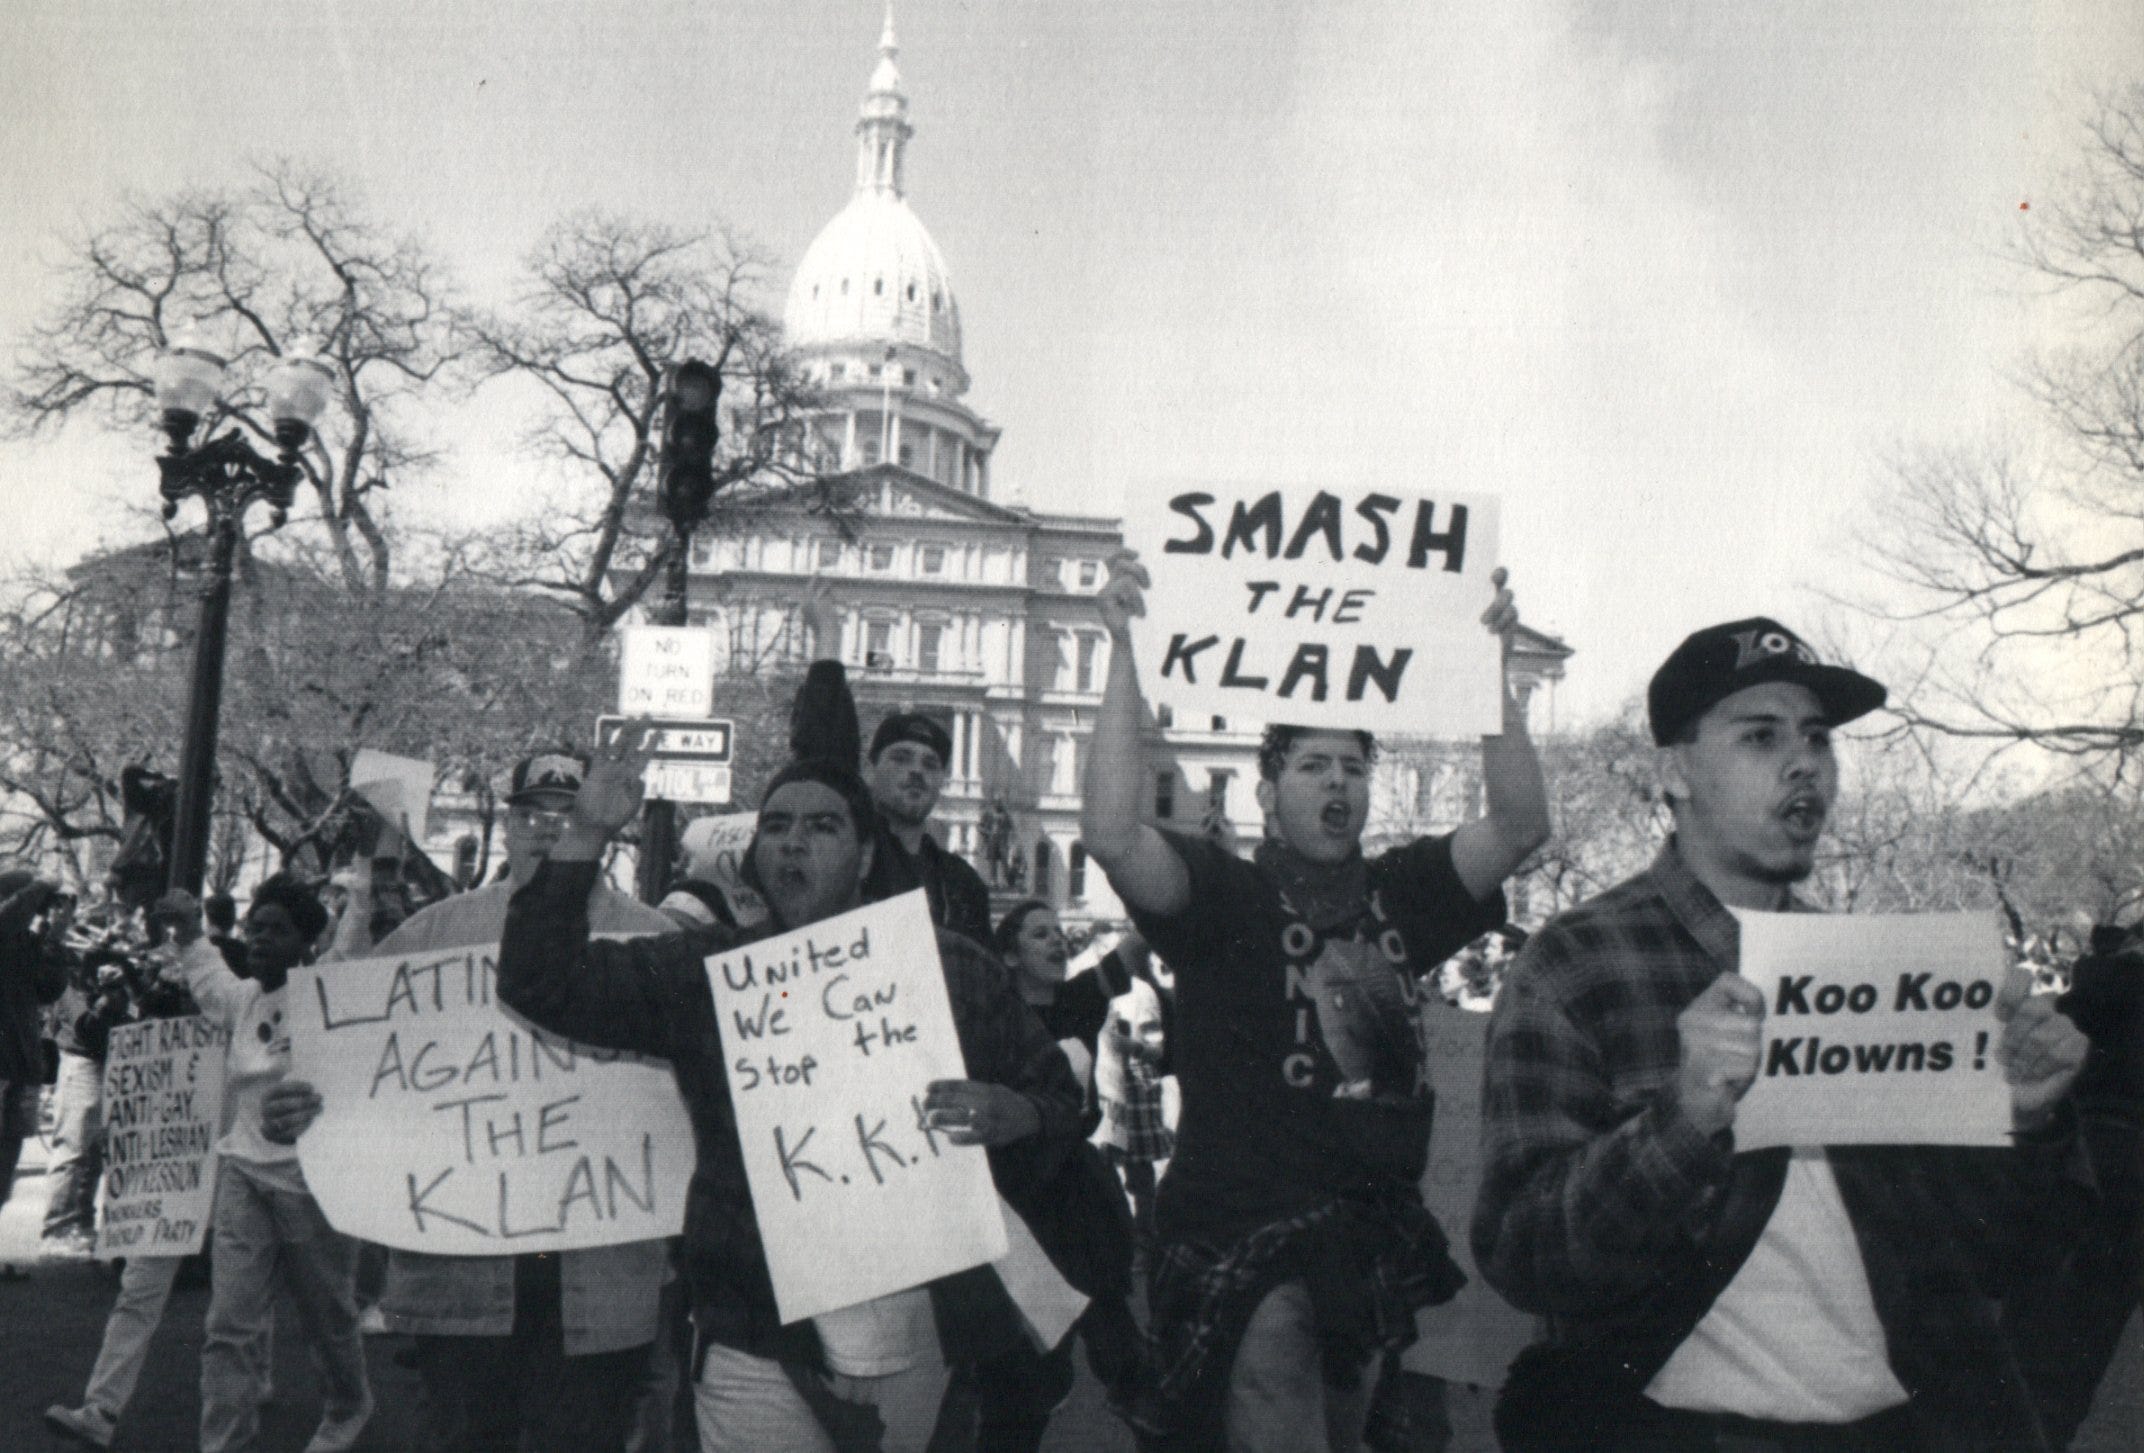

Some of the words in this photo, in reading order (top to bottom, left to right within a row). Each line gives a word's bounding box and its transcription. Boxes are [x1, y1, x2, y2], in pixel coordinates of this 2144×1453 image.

[1163, 490, 1468, 573] SMASH
[1246, 581, 1376, 623] THE
[654, 636, 682, 656] NO
[1161, 633, 1413, 703] KLAN
[646, 661, 692, 680] TURN
[627, 686, 653, 703] ON
[665, 687, 704, 705] RED
[680, 734, 717, 749] WAY
[1775, 975, 1878, 1016] Koo
[1894, 972, 1994, 1012] Koo
[733, 993, 792, 1040] We
[369, 1030, 645, 1099] AGAIN
[736, 1055, 818, 1091] Stop
[853, 1018, 918, 1056] the
[1765, 1036, 1954, 1077] Klowns
[433, 1095, 580, 1163] THE
[407, 1132, 654, 1238] KLAN
